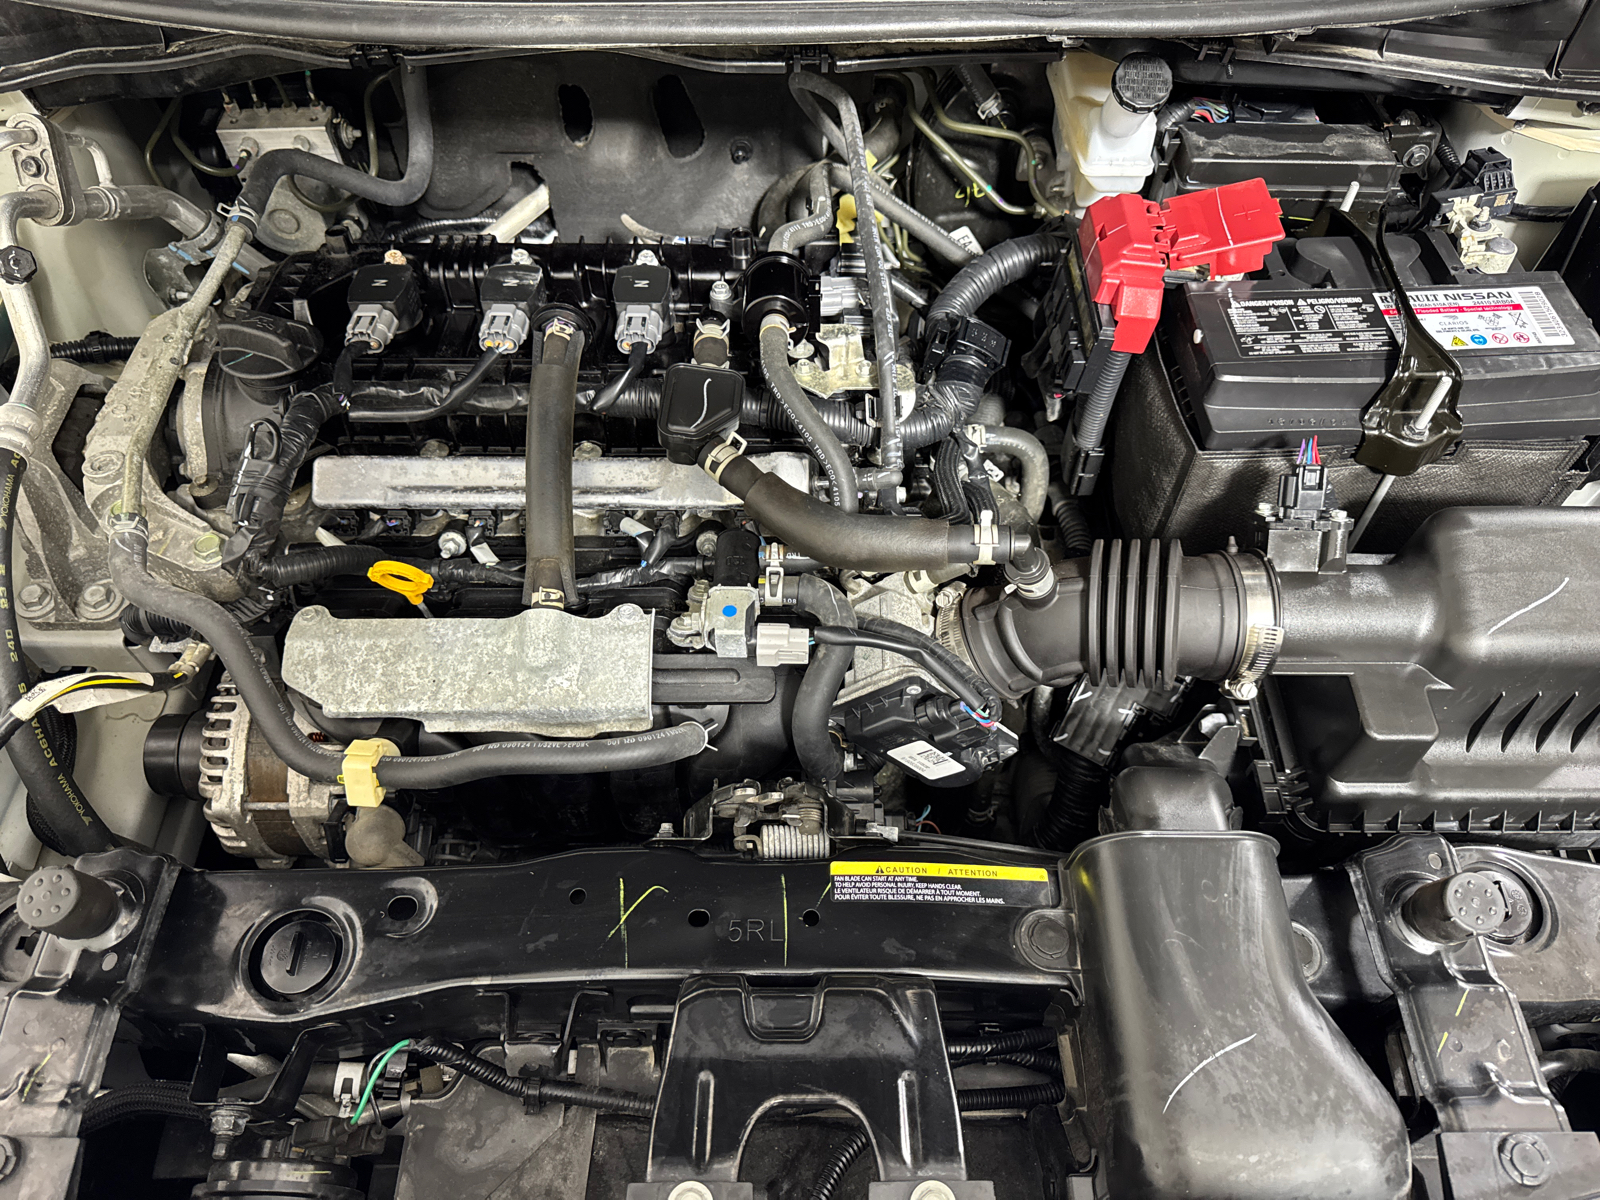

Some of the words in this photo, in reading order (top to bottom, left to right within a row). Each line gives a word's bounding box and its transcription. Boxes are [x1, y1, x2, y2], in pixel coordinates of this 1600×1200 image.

[1306, 297, 1363, 305] PELIGRO/VENENO
[1443, 291, 1512, 301] NISSAN
[1240, 299, 1295, 307] DANGER/POISON
[1, 474, 15, 517] YOKOHAMA
[57, 772, 86, 816] YOKOHAMA
[885, 866, 928, 874] CAUTION
[948, 868, 998, 877] ATTENTION
